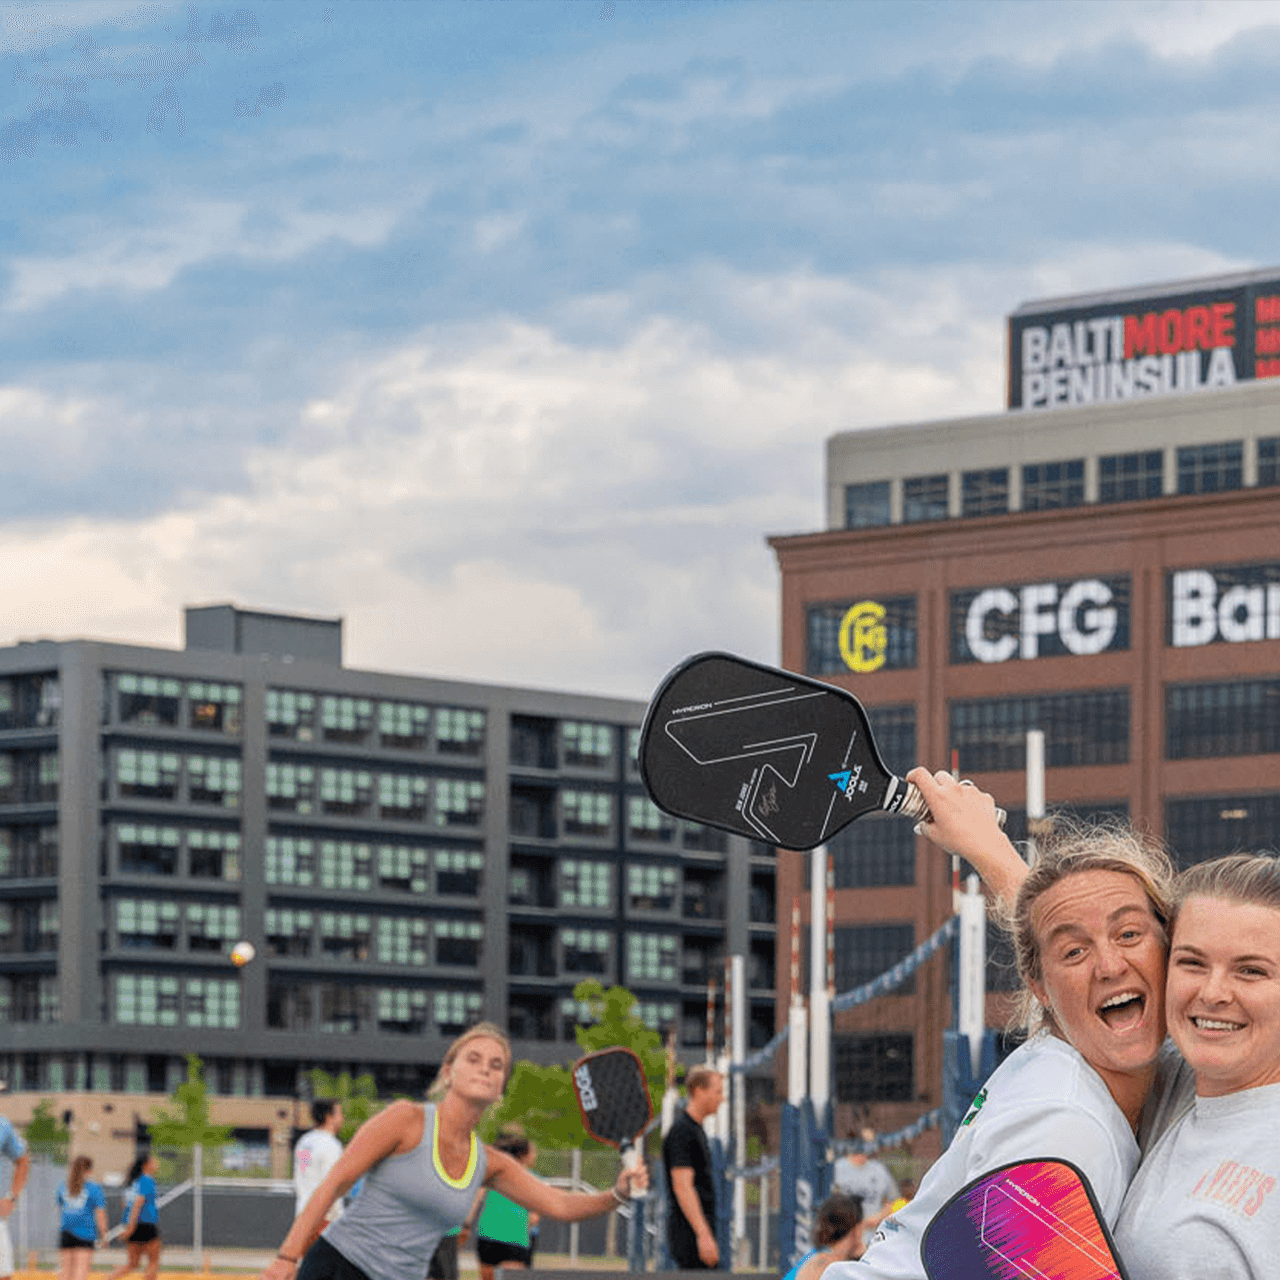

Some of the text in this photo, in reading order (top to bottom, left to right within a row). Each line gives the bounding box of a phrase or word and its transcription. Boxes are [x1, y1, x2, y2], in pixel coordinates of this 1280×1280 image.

[1021, 302, 1237, 373] BALTIMORE
[1021, 346, 1237, 409] PENINSULA
[966, 580, 1118, 663] CFG
[845, 764, 863, 802] JOOLA
